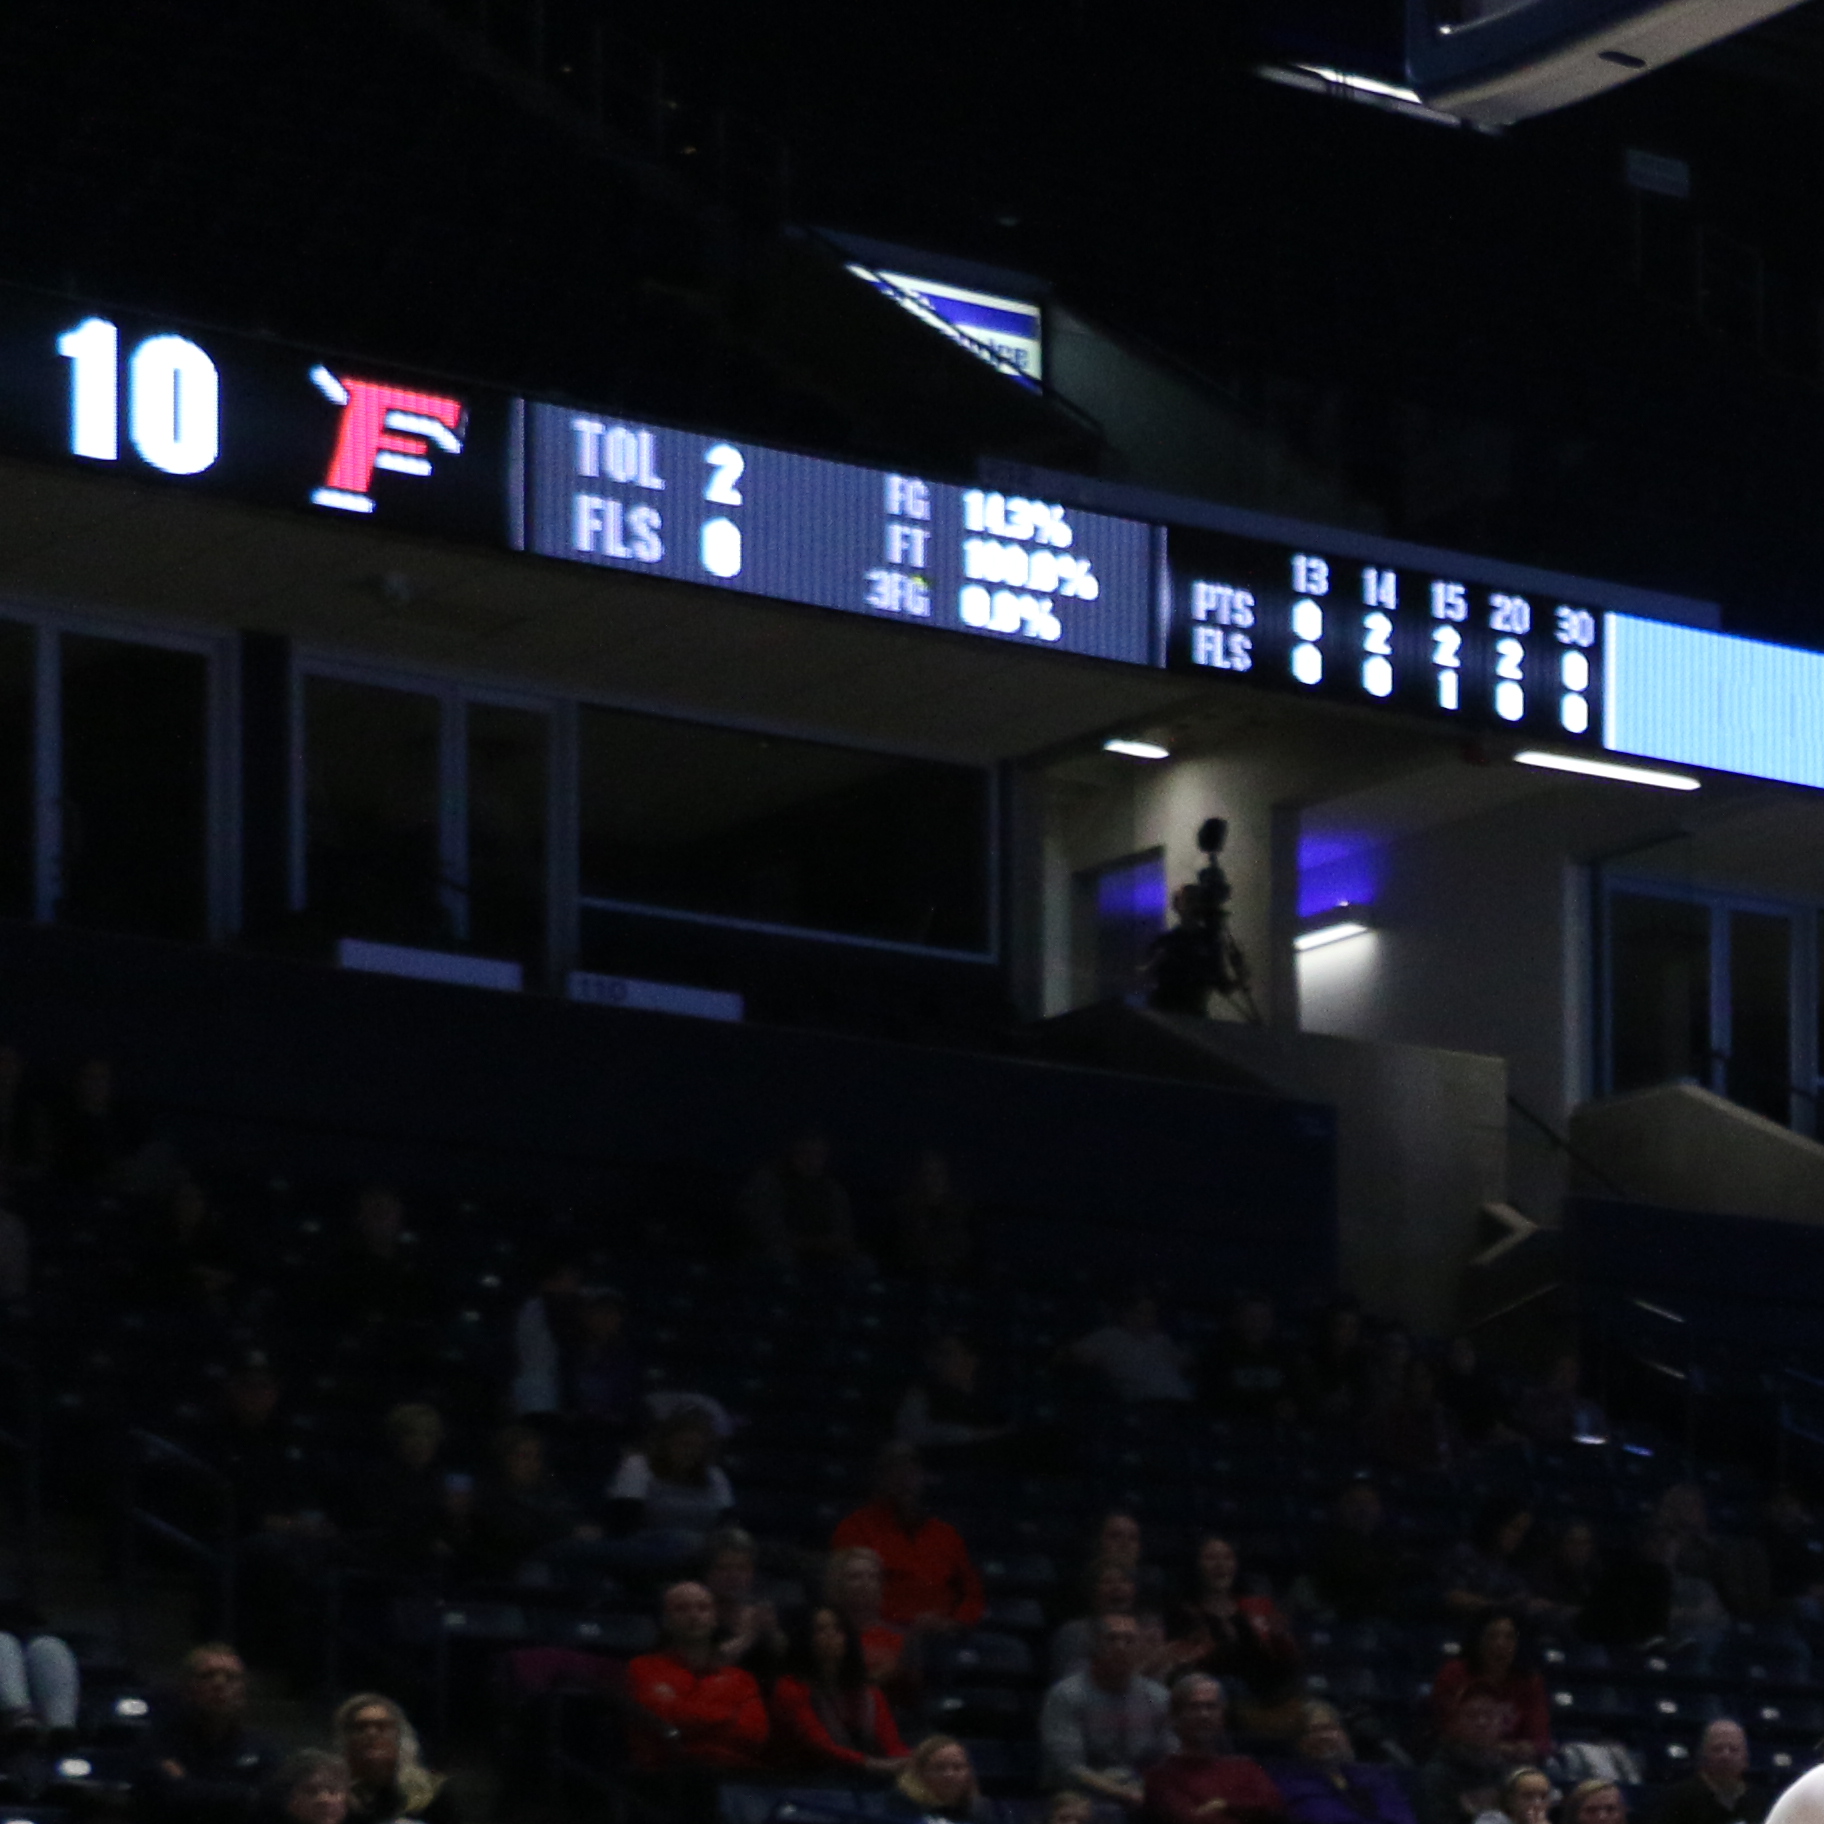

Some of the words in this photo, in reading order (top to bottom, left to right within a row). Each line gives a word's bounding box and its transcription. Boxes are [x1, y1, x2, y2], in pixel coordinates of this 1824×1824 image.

[57, 316, 220, 475] 10
[573, 419, 665, 489] TOL
[703, 442, 744, 506] 2
[573, 495, 663, 563] FLS
[700, 516, 743, 577] 0
[1191, 580, 1255, 629] PTS
[1362, 612, 1393, 656] 2
[1432, 625, 1462, 668] 2
[1495, 637, 1525, 680] 2
[1291, 555, 1329, 596] 13
[1362, 566, 1397, 610] 14
[1430, 580, 1468, 622] 15
[1489, 593, 1531, 634] 20
[1554, 604, 1595, 648] 30
[1191, 626, 1253, 672] FLS
[1438, 668, 1459, 711] 1
